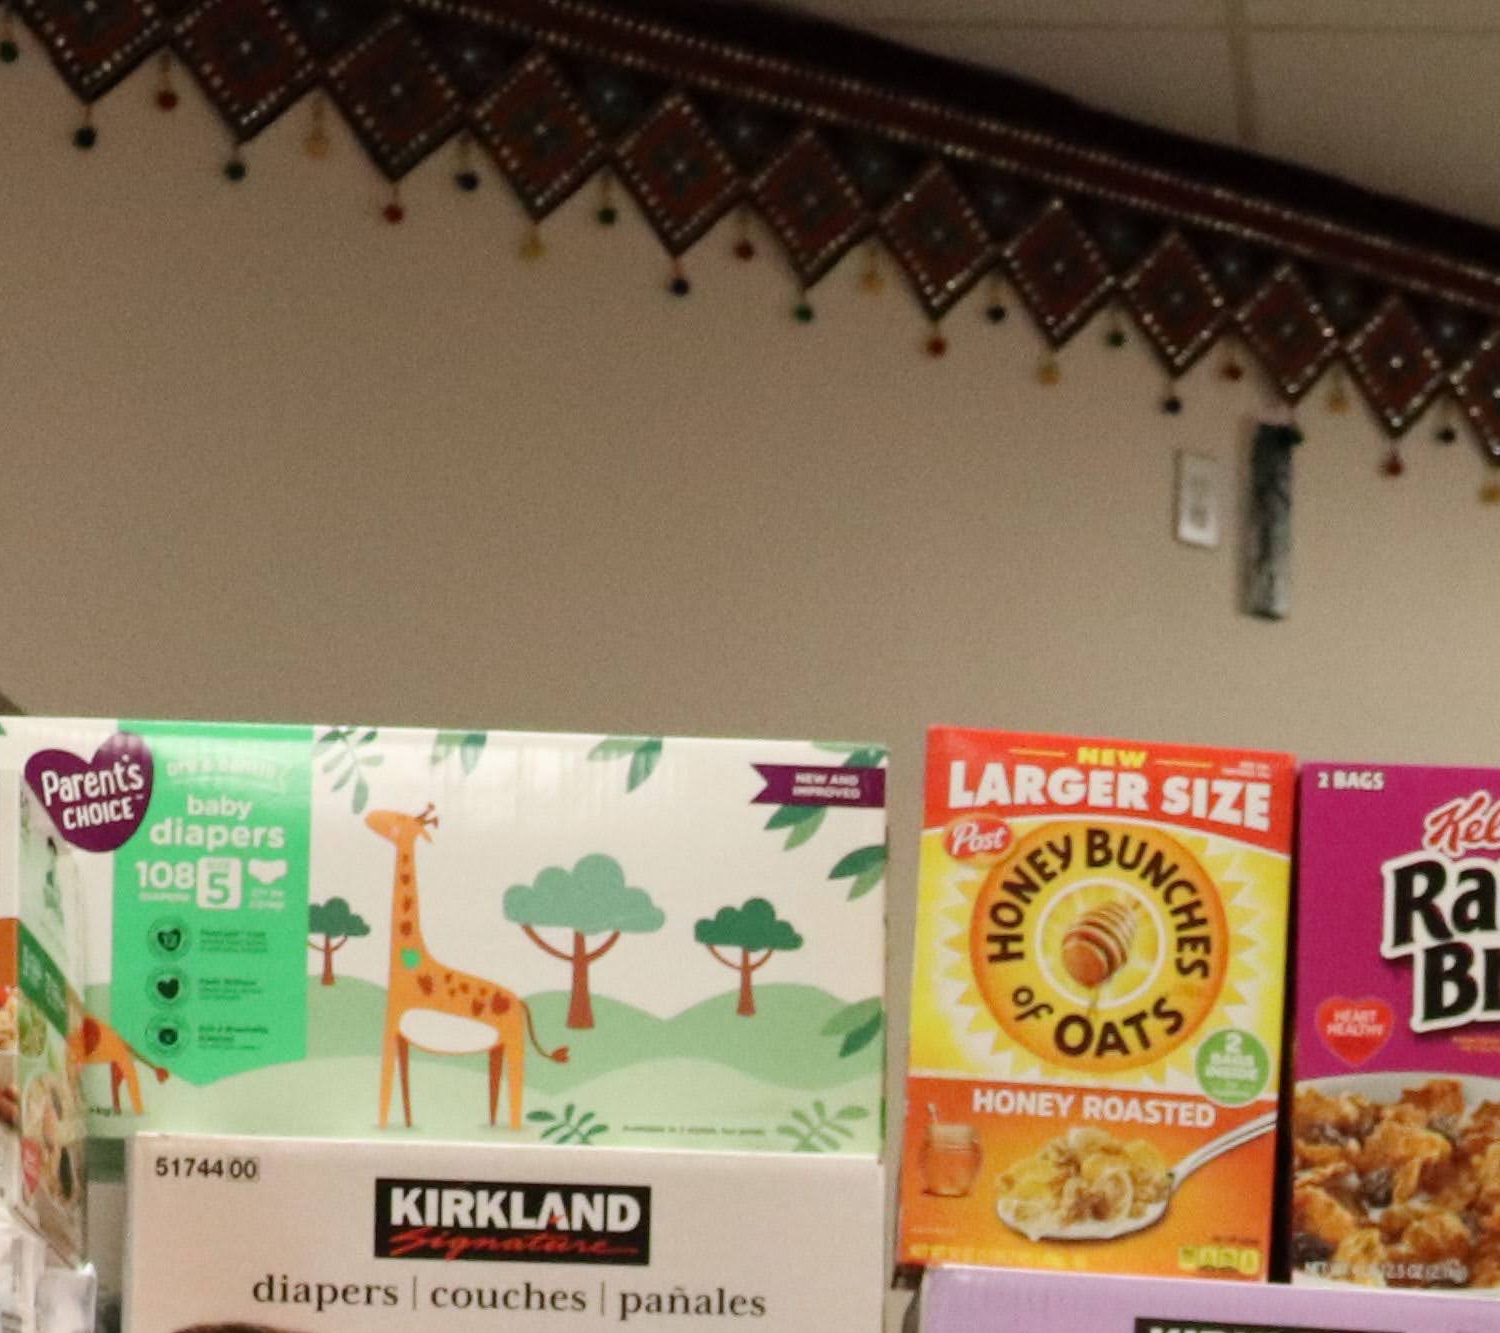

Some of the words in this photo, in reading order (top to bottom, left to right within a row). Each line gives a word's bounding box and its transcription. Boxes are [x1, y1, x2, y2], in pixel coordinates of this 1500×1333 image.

[1077, 747, 1147, 768] NEW
[41, 753, 145, 807] Parent's
[948, 760, 1150, 811] LARGER
[1160, 775, 1271, 831] SIZE
[1317, 771, 1329, 789] 2
[1333, 771, 1385, 791] BAGS
[62, 796, 135, 831] CHOICE
[187, 794, 253, 821] baby
[149, 817, 286, 850] diapers
[950, 820, 1007, 855] Post
[135, 860, 196, 889] 108
[207, 872, 231, 905] 5
[986, 833, 1073, 964] HONEY
[1085, 827, 1213, 980] BUNCHES
[1012, 985, 1054, 1023] of
[1053, 997, 1186, 1059] OATS
[1223, 1033, 1243, 1053] 2
[972, 1088, 1075, 1118] HONEY
[1082, 1094, 1217, 1129] ROASTED
[389, 1187, 641, 1233] KIRKLAND
[389, 1226, 638, 1262] Signature
[252, 1275, 399, 1310] diapers
[430, 1281, 588, 1313] couches
[618, 1283, 768, 1321] pañales
